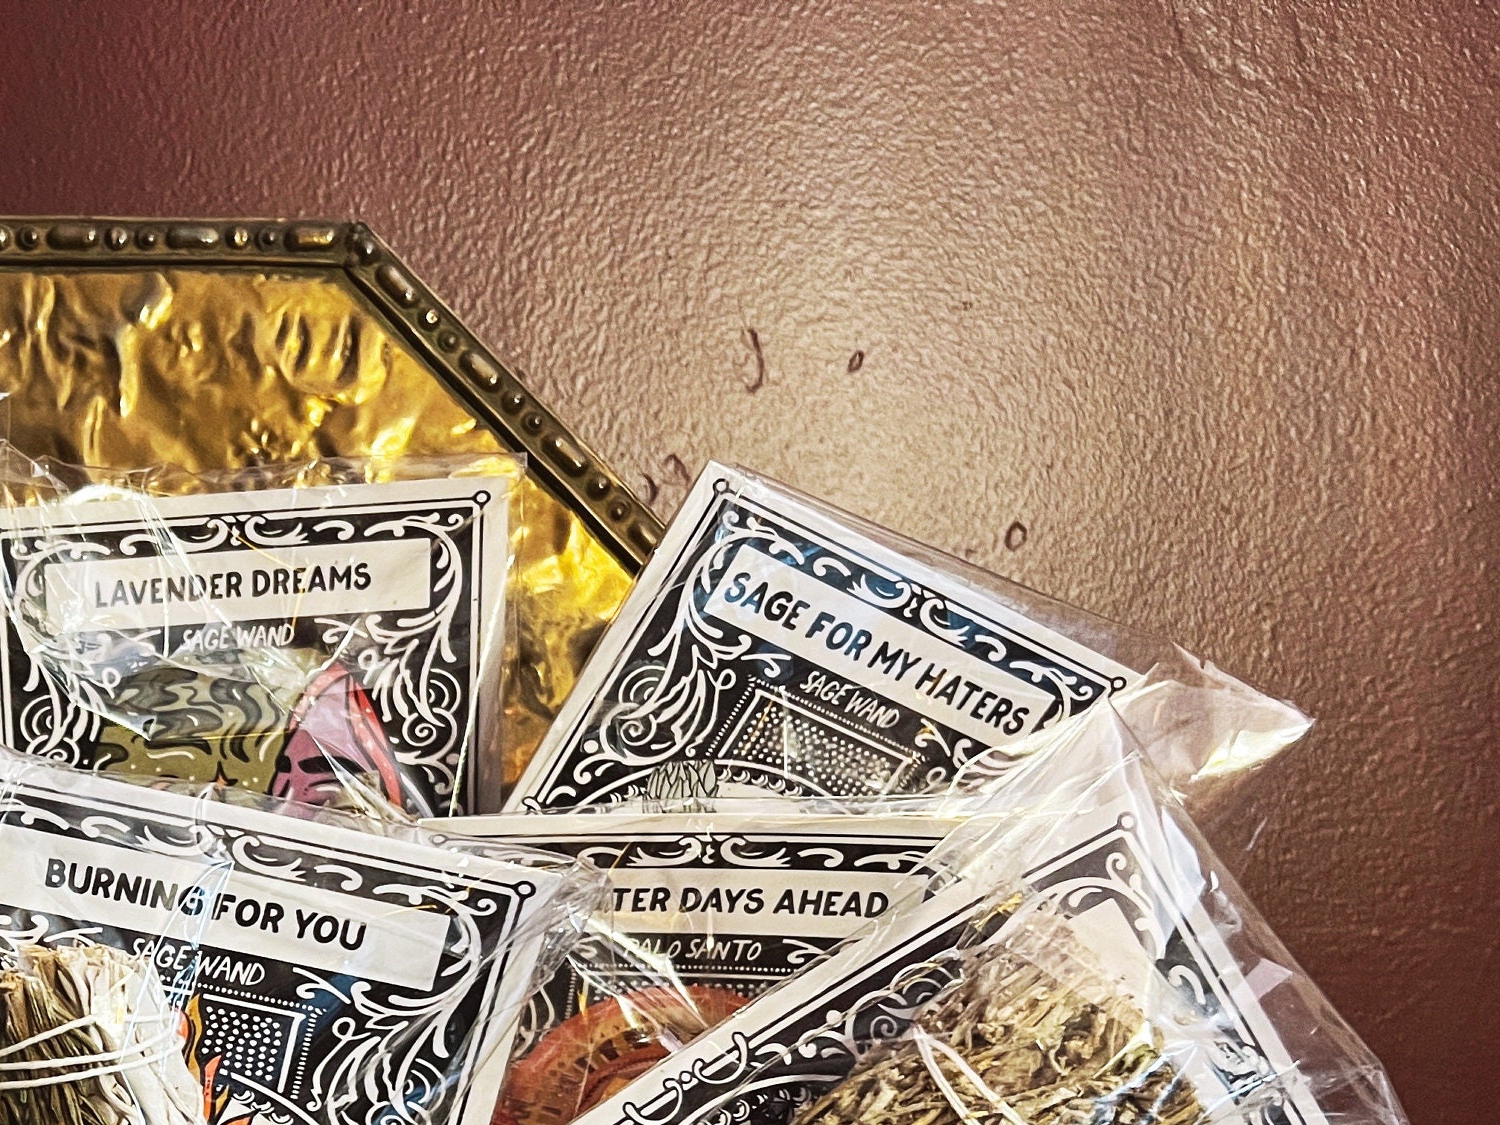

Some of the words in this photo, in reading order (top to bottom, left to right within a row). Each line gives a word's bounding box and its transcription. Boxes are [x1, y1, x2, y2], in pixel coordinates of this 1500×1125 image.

[95, 571, 243, 608] LAVENDER
[252, 562, 372, 598] DREAMS
[183, 626, 230, 650] SAGE
[232, 624, 295, 648] WAND
[724, 572, 811, 631] SAGE
[805, 611, 873, 662] FOR
[867, 641, 922, 682] MY
[914, 663, 1030, 736] HATERS
[800, 670, 850, 706] SAGE
[844, 690, 900, 729] WAND
[45, 858, 206, 916] BURNING
[211, 893, 285, 933] FOR
[296, 909, 367, 951] YOU
[608, 887, 671, 912] TER
[679, 887, 764, 915] DAYS
[773, 888, 889, 918] AHEAD
[131, 937, 192, 971] SAGE
[194, 951, 266, 986] WAND
[685, 938, 762, 962] SANTO
